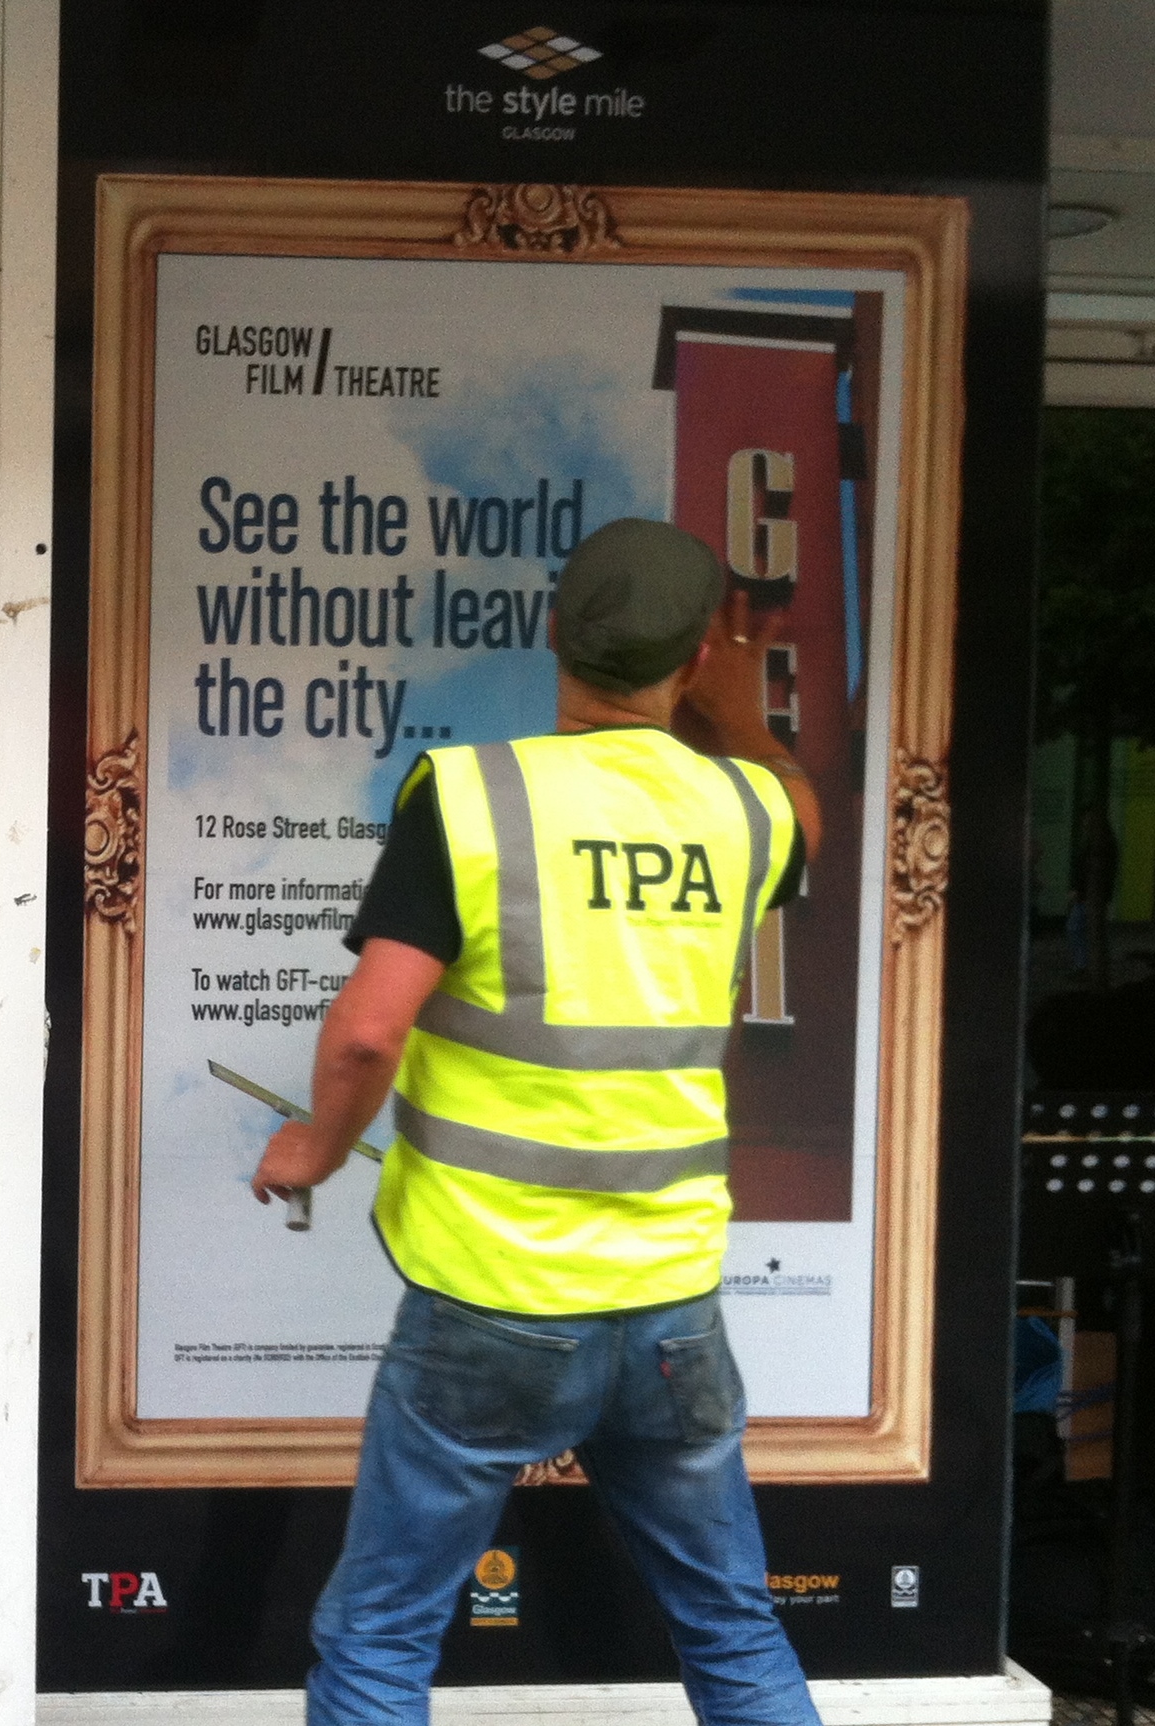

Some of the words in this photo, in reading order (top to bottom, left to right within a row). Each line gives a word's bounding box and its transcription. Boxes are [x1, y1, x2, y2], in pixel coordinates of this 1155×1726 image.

[445, 84, 493, 113] the
[502, 85, 577, 122] style
[584, 87, 645, 117] mile
[502, 125, 577, 141] GLASGOW
[195, 324, 313, 358] GLASGOW
[246, 363, 304, 396] FILM
[333, 365, 441, 398] THEATRE
[198, 476, 299, 555] See
[319, 475, 408, 557] the
[428, 478, 585, 559] world
[196, 566, 414, 648] without
[194, 657, 284, 738] the
[304, 659, 453, 760] city...
[195, 814, 217, 838] 12
[223, 815, 267, 839] Rose
[272, 815, 331, 841] Street,
[337, 816, 387, 846] Glasg
[194, 876, 224, 900] For
[229, 882, 276, 900] more
[572, 839, 723, 914] TPA
[191, 968, 211, 991] To
[216, 968, 271, 992] watch
[276, 968, 349, 992] GFT-cur
[81, 1571, 168, 1607] TPA
